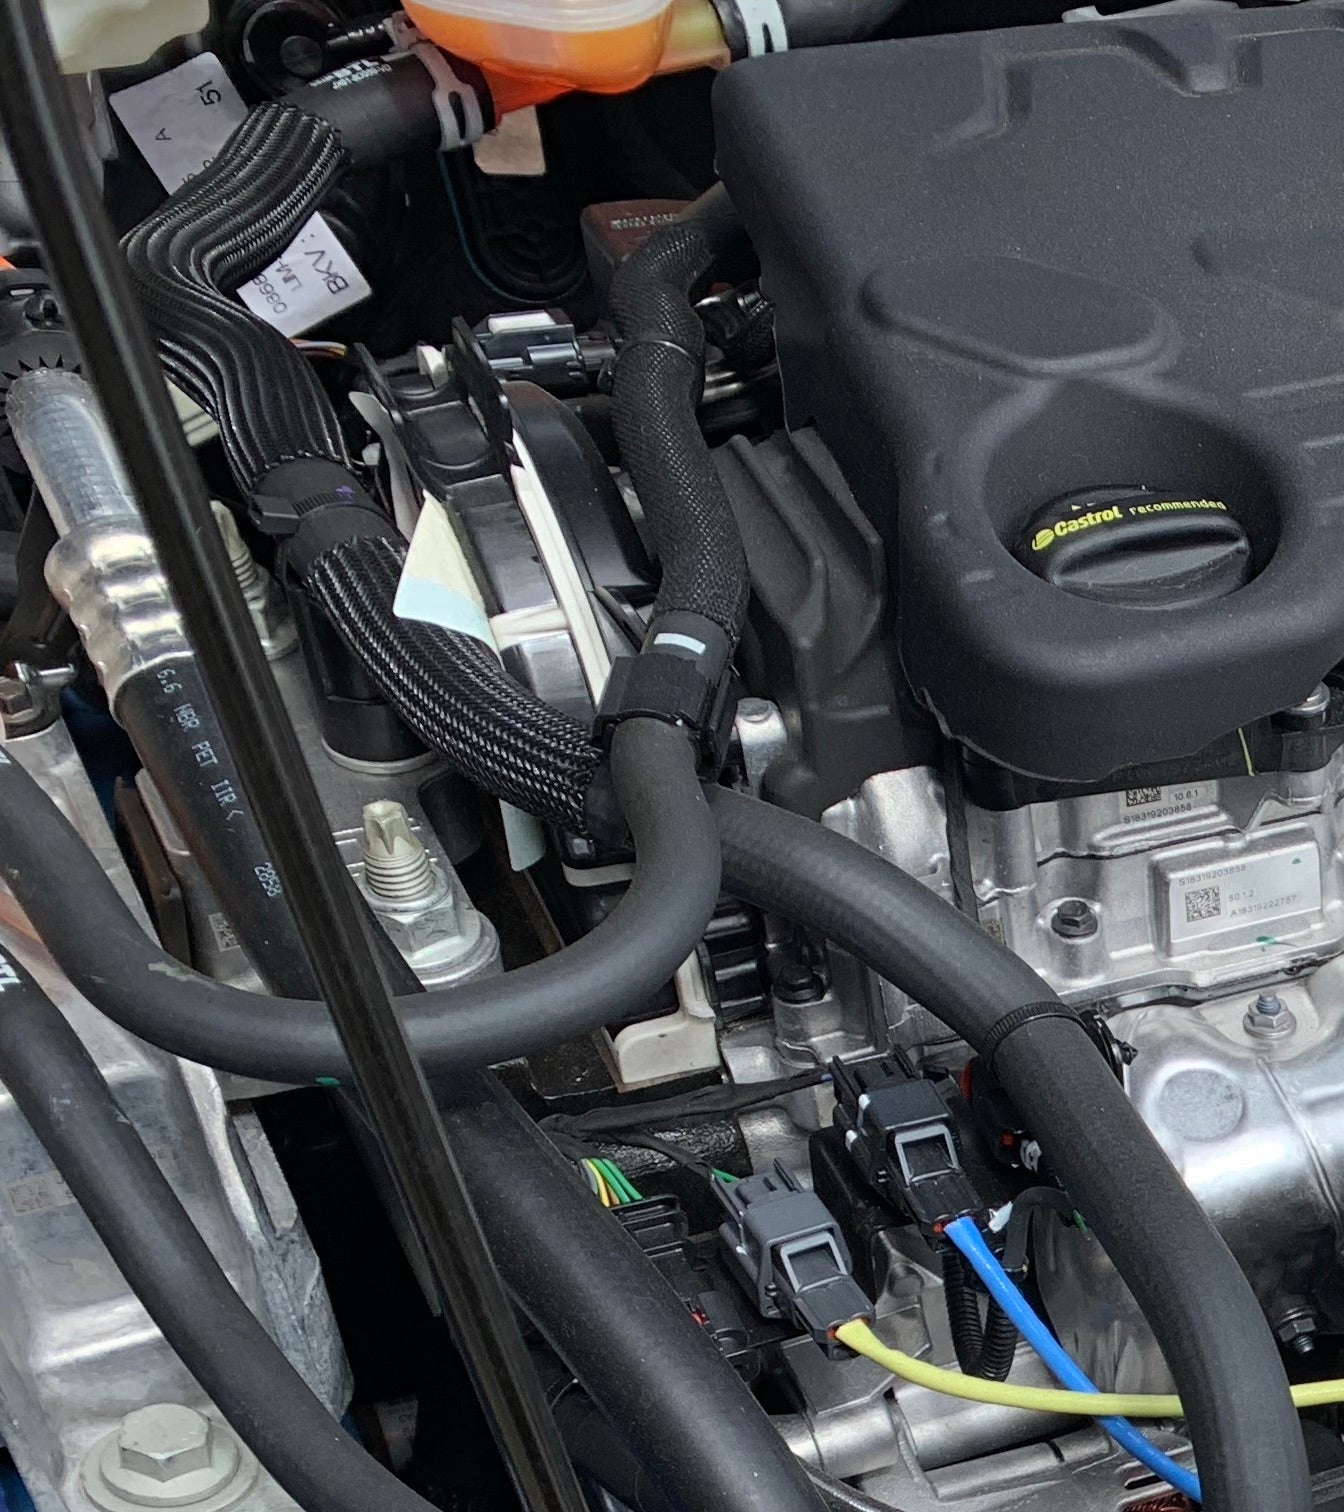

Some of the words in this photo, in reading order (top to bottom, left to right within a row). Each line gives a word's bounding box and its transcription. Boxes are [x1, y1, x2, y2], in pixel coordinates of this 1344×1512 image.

[195, 80, 221, 106] 51
[1054, 506, 1123, 536] Castrol
[1129, 499, 1226, 515] recommended
[192, 740, 218, 767] PET
